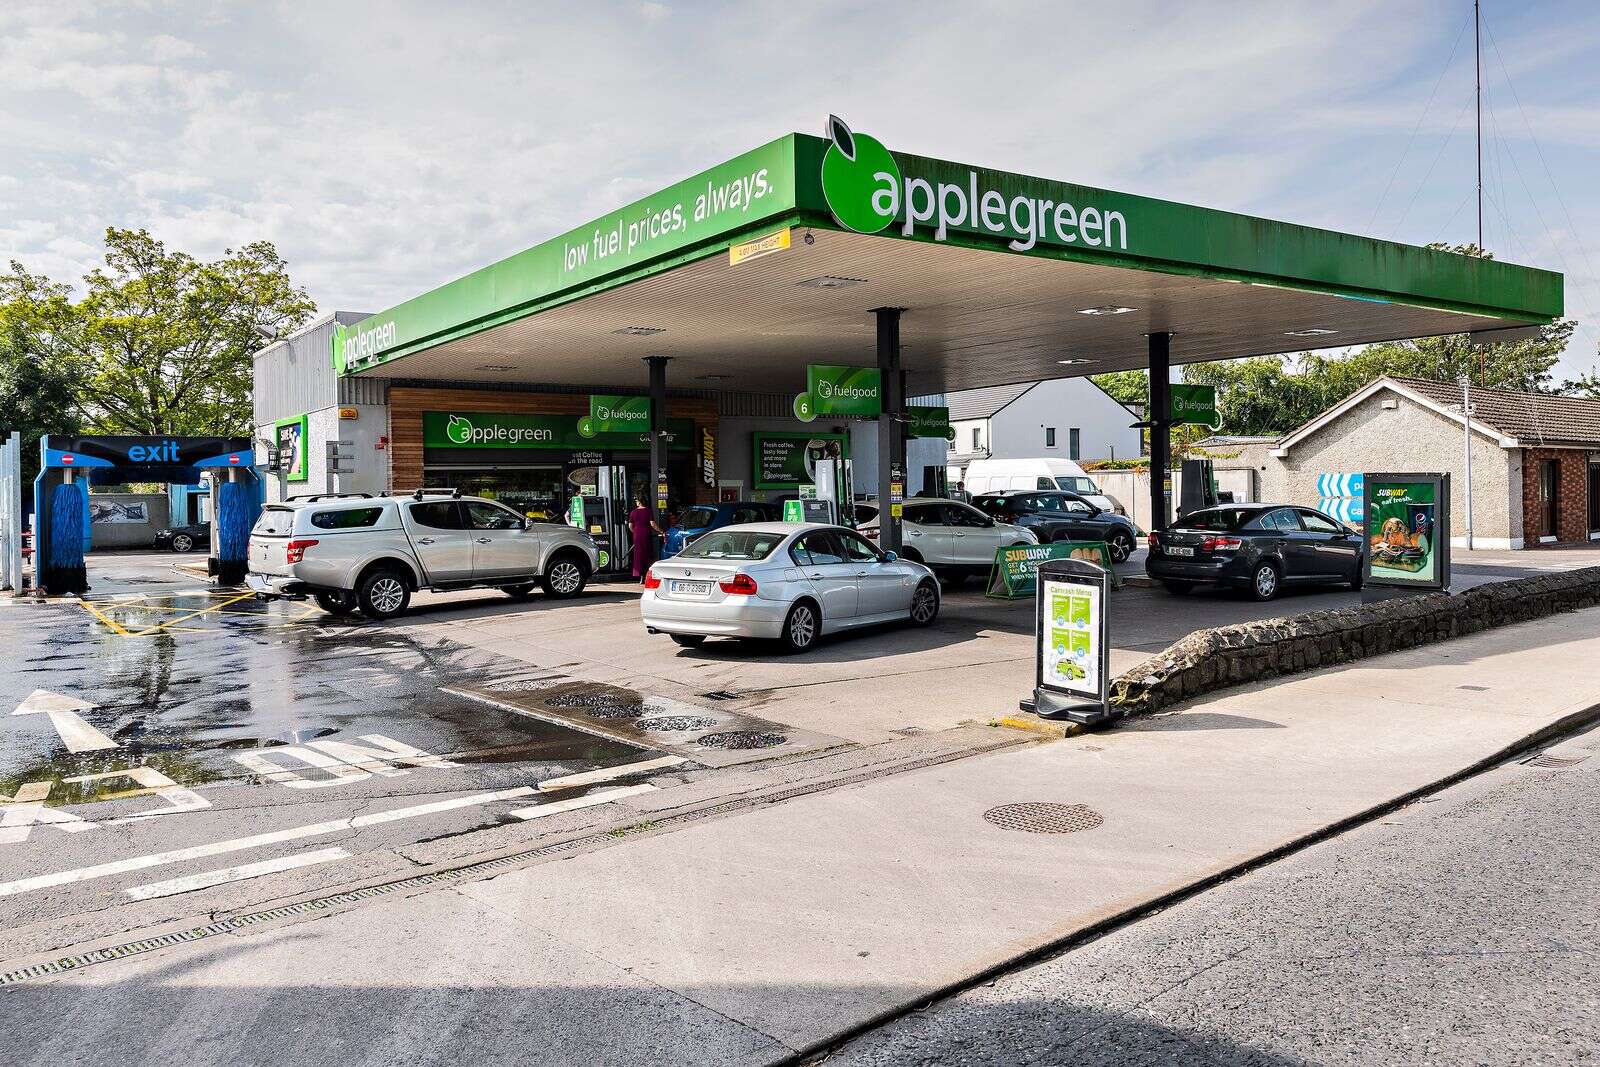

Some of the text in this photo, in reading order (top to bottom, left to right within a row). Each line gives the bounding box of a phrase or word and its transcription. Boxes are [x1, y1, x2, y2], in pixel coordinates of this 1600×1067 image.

[871, 171, 1128, 252] applegreen
[565, 168, 774, 272] low fuel prices, always.
[343, 321, 396, 369] applegreen
[834, 386, 877, 399] fuelgood
[801, 403, 808, 414] 6
[1184, 400, 1213, 412] fuelgood
[611, 410, 647, 420] fuelgood
[583, 424, 590, 433] 4
[920, 417, 948, 427] fuelgood
[460, 424, 552, 444] applegreen
[128, 441, 180, 461] exit
[703, 427, 715, 488] SUBWAY
[1377, 489, 1408, 497] SUBWAY
[1005, 548, 1051, 561] SUBWAY
